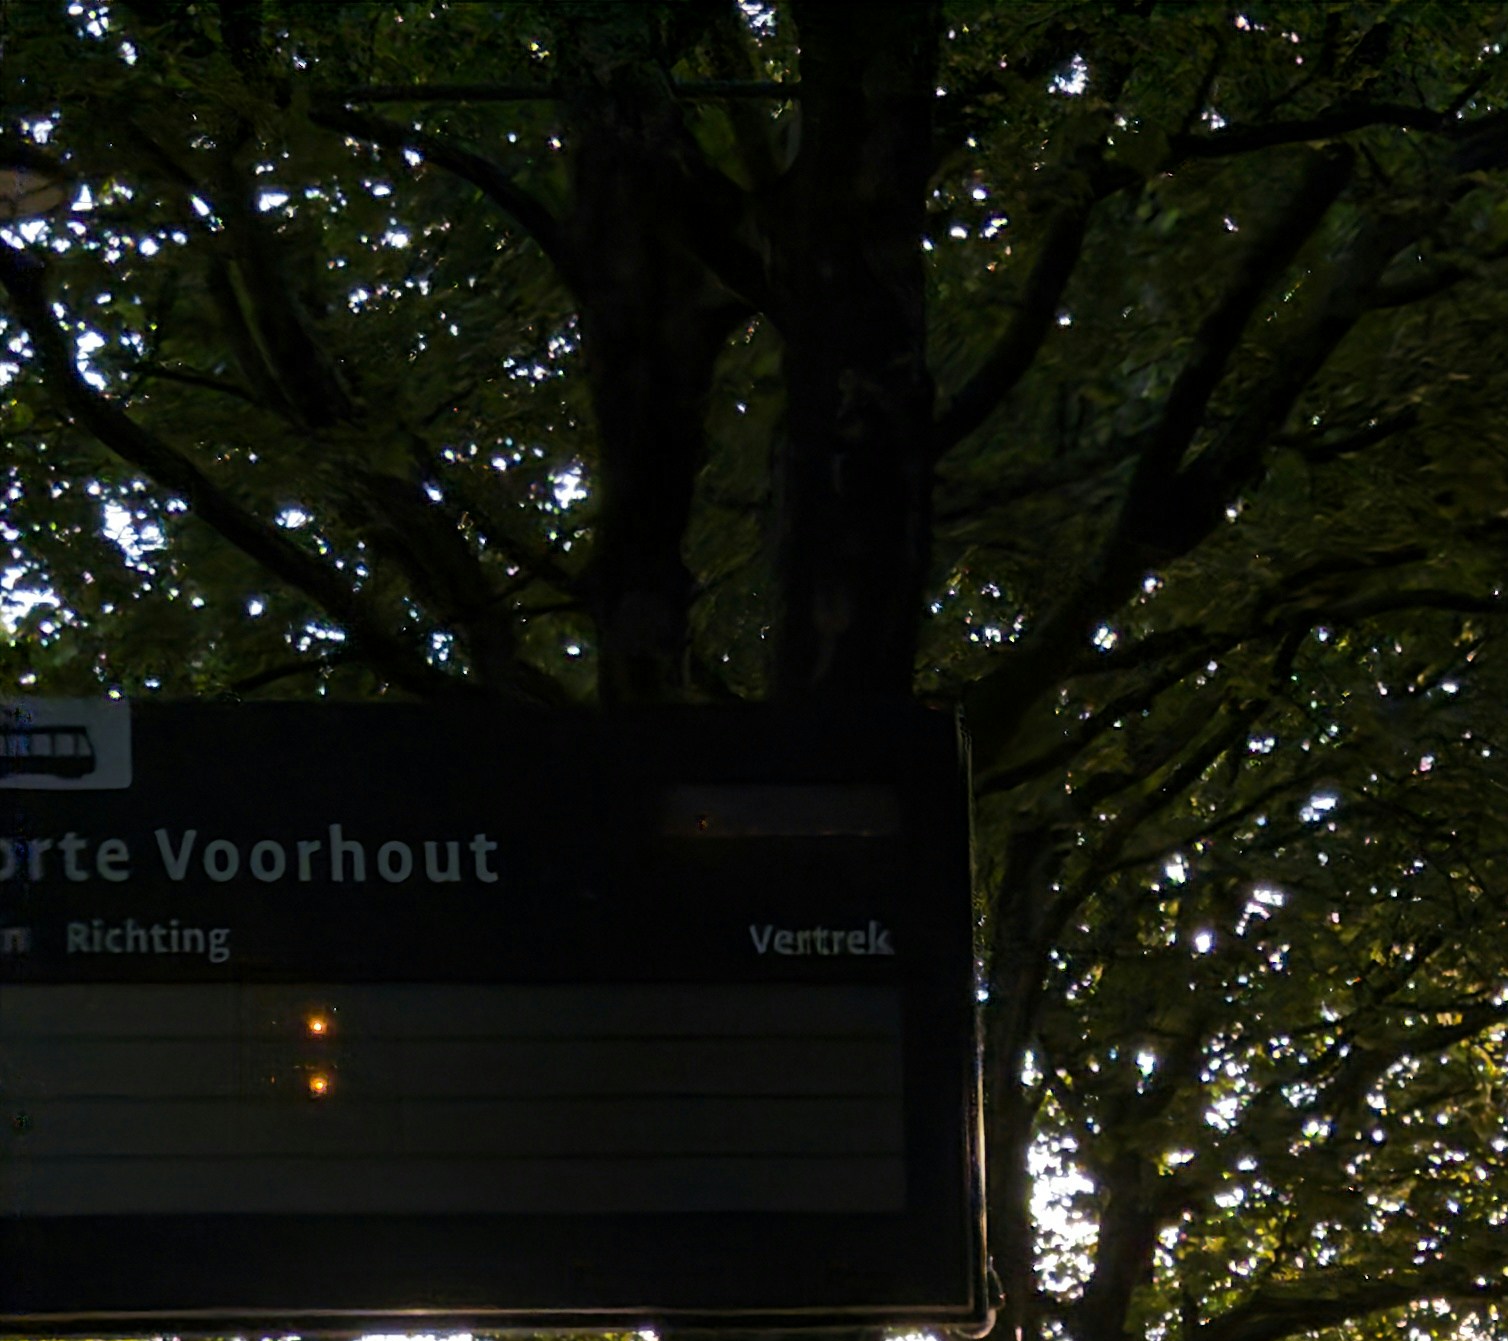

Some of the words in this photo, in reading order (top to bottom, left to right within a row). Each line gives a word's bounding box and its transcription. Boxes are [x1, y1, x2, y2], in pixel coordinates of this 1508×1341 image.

[154, 823, 499, 883] Voorhout
[67, 918, 230, 963] Richting
[749, 920, 895, 956] Vertrek
